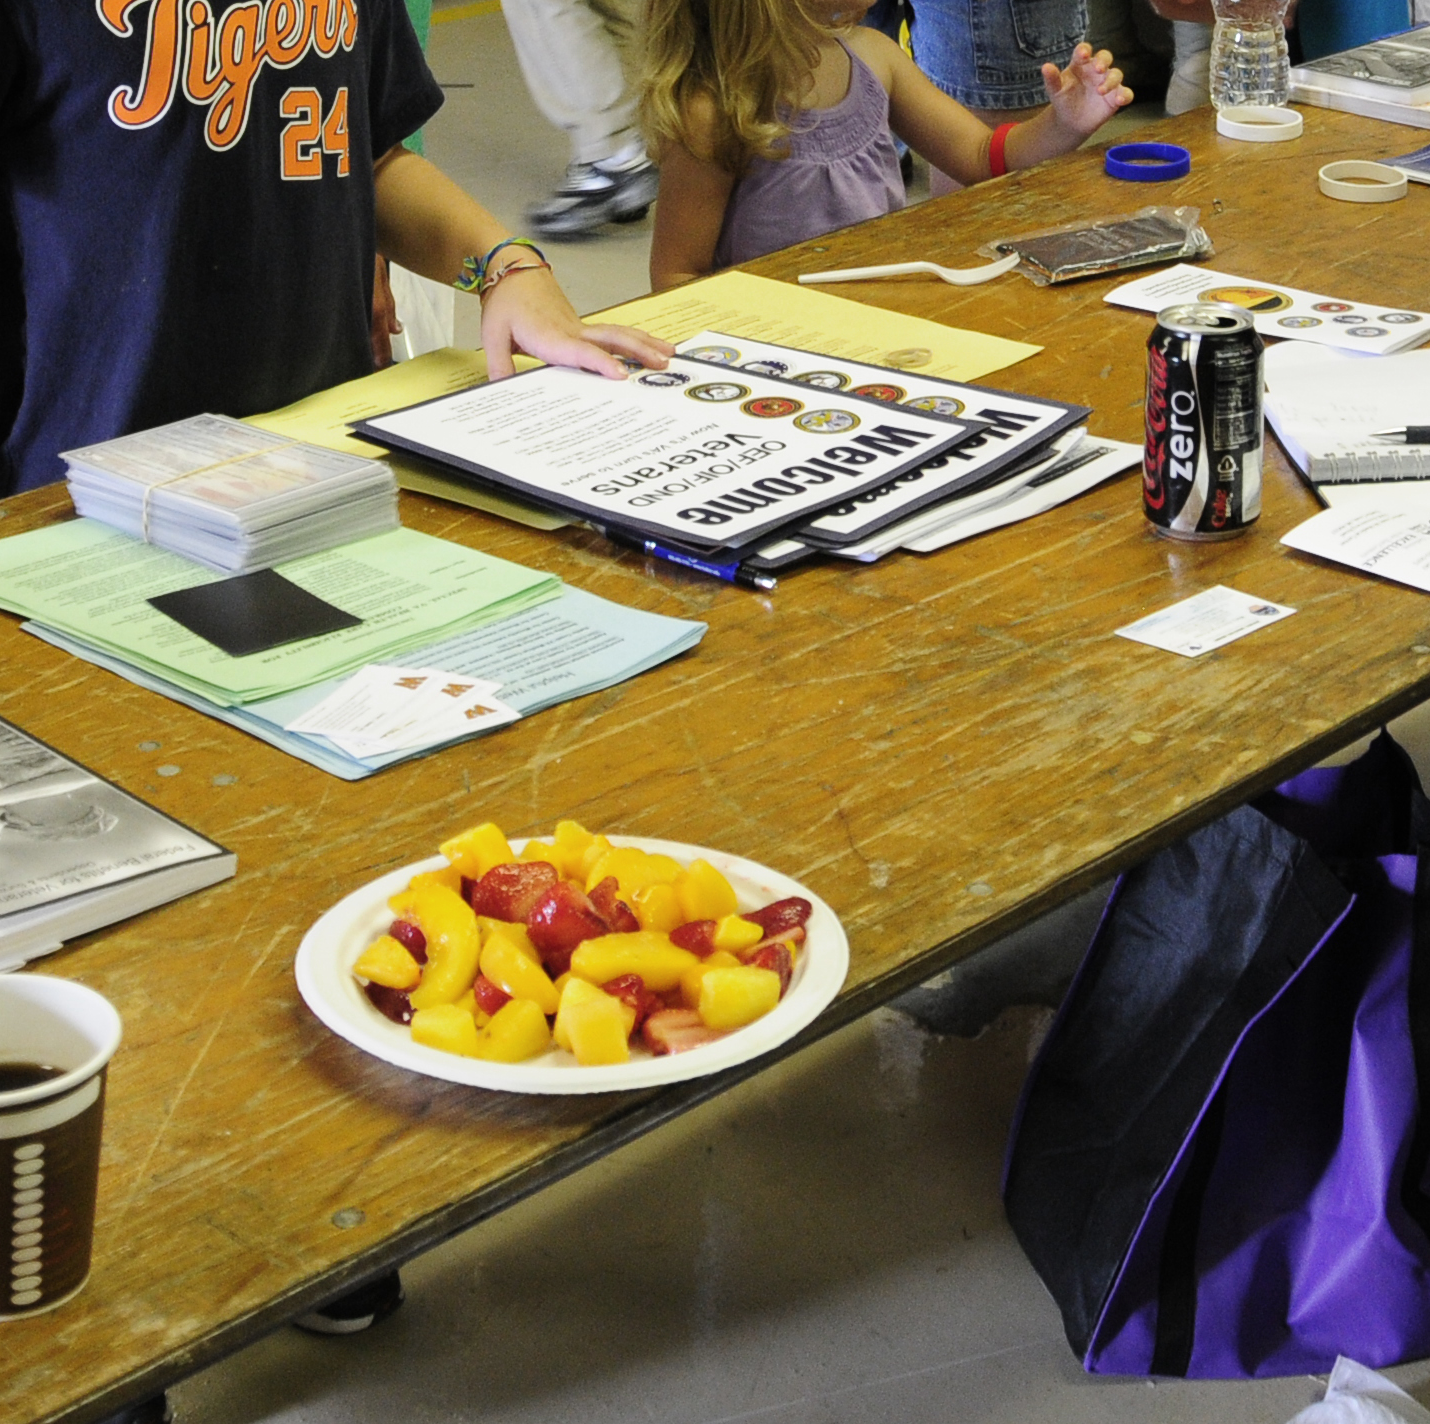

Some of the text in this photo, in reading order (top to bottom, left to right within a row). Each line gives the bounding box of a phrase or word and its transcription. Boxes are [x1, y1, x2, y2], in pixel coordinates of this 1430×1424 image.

[280, 86, 350, 181] 24
[690, 422, 720, 436] Now
[1170, 391, 1195, 482] zero
[641, 444, 672, 456] VA's
[591, 432, 765, 497] Veterans
[598, 465, 614, 473] to
[613, 455, 643, 467] turn
[561, 472, 596, 487] serve
[628, 440, 787, 508] OEF/OIF/OND
[676, 424, 936, 526] Welcome
[143, 844, 196, 863] Federal
[84, 856, 141, 879] Benefits
